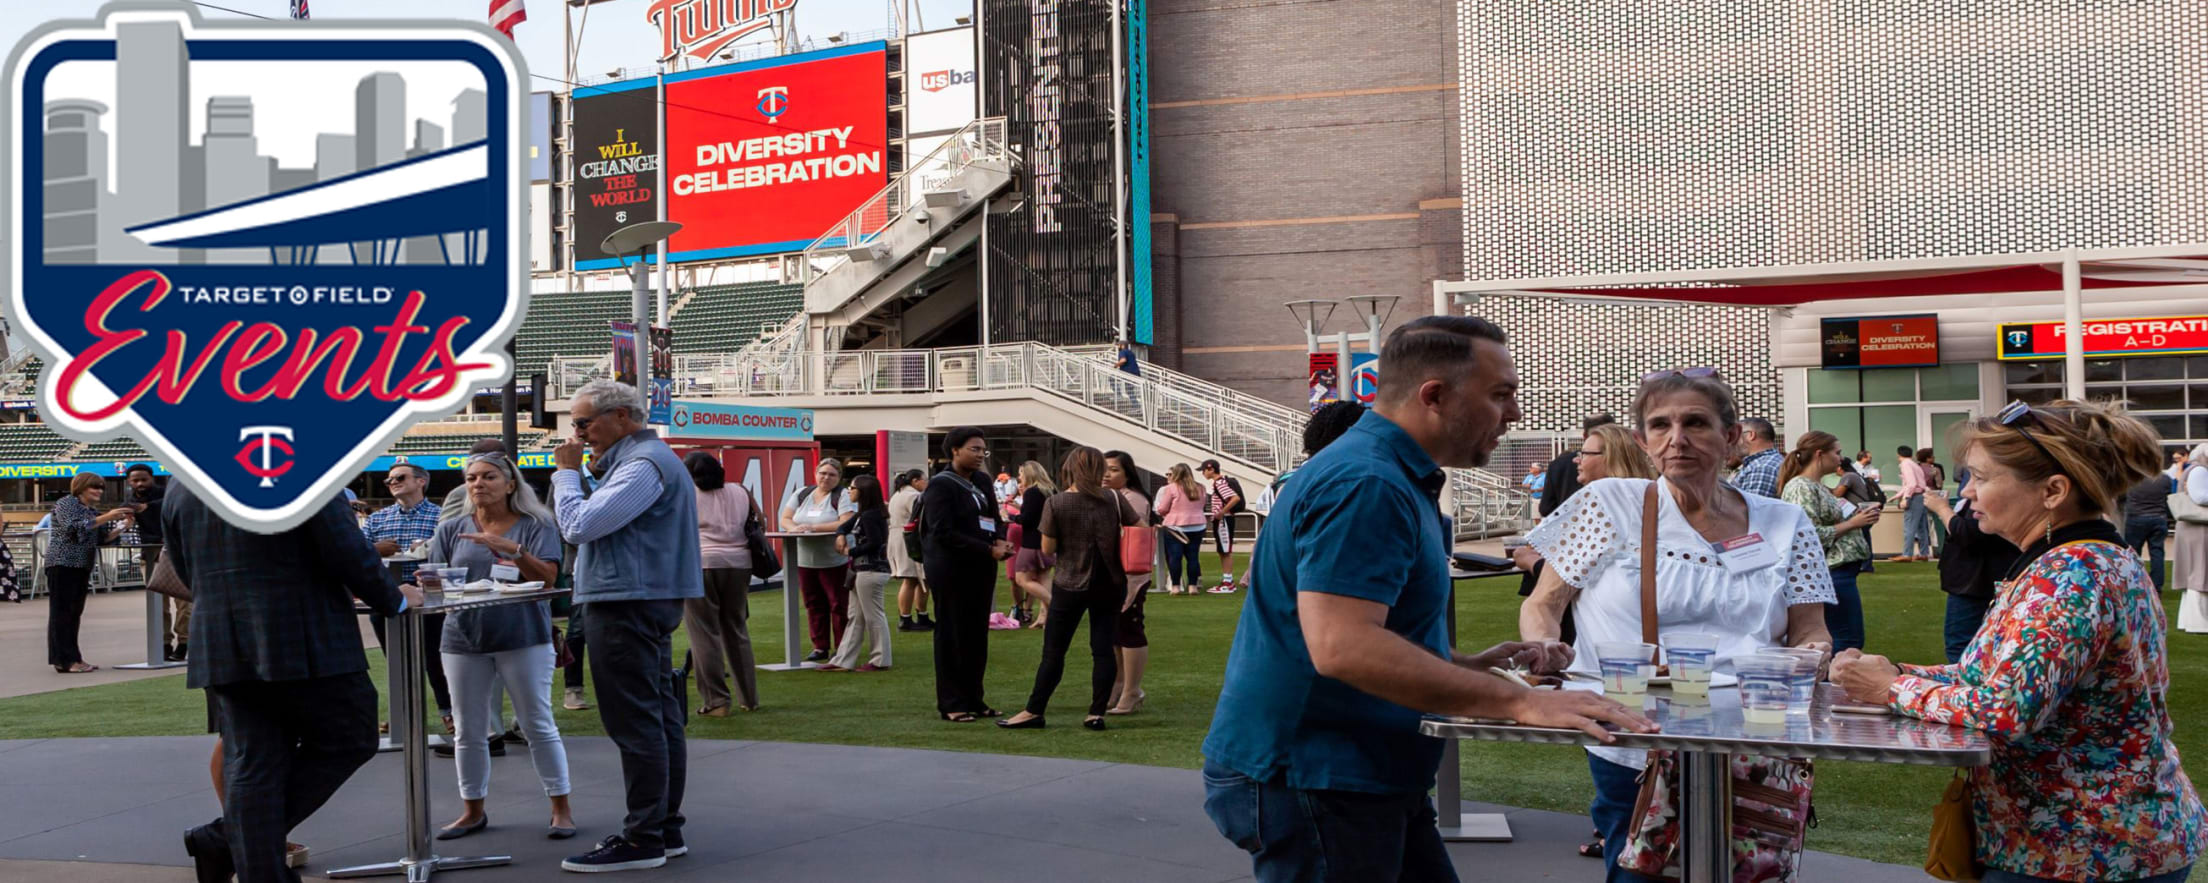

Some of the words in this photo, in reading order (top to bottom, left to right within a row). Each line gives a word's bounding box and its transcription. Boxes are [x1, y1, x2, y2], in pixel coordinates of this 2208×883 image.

[616, 128, 624, 143] I
[598, 142, 642, 159] WILL
[696, 126, 854, 167] DIVERSITY
[580, 154, 658, 179] CHANGE
[673, 151, 880, 196] CELEBRATION
[604, 175, 638, 191] THE
[590, 188, 651, 207] WORLD
[1861, 342, 1936, 352] CELEBRATION
[1869, 335, 1926, 344] DIVERSITY
[2124, 334, 2166, 348] A-D
[692, 411, 741, 427] BOMBA
[742, 414, 798, 429] COUNTER
[0, 464, 80, 477] DIVERSITY
